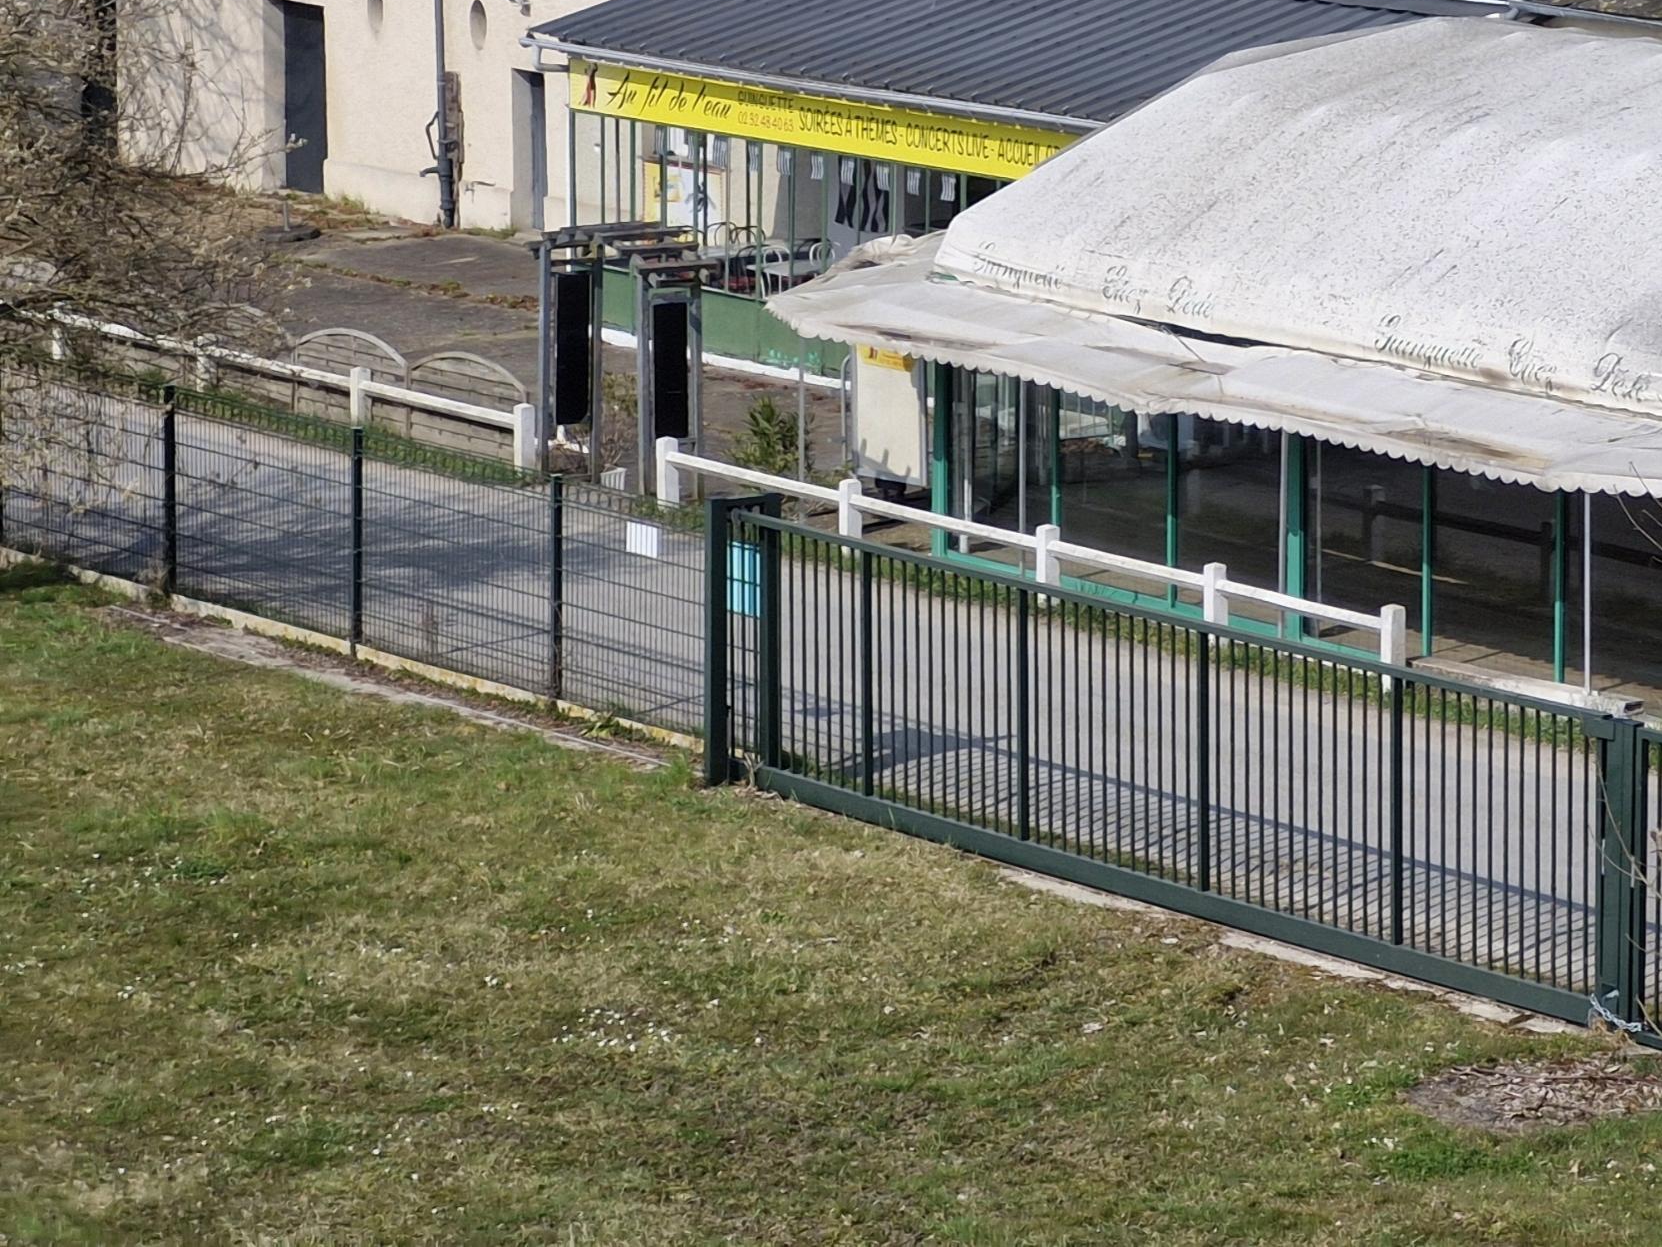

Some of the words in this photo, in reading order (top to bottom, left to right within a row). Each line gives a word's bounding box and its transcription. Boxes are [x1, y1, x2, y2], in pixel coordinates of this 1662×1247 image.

[607, 71, 637, 110] Au
[638, 76, 669, 116] fil
[669, 79, 687, 112] de
[691, 83, 732, 120] l'eau
[799, 105, 843, 137] SOIRÉES
[905, 122, 965, 156] CONCERTS
[965, 132, 990, 159] LIVE
